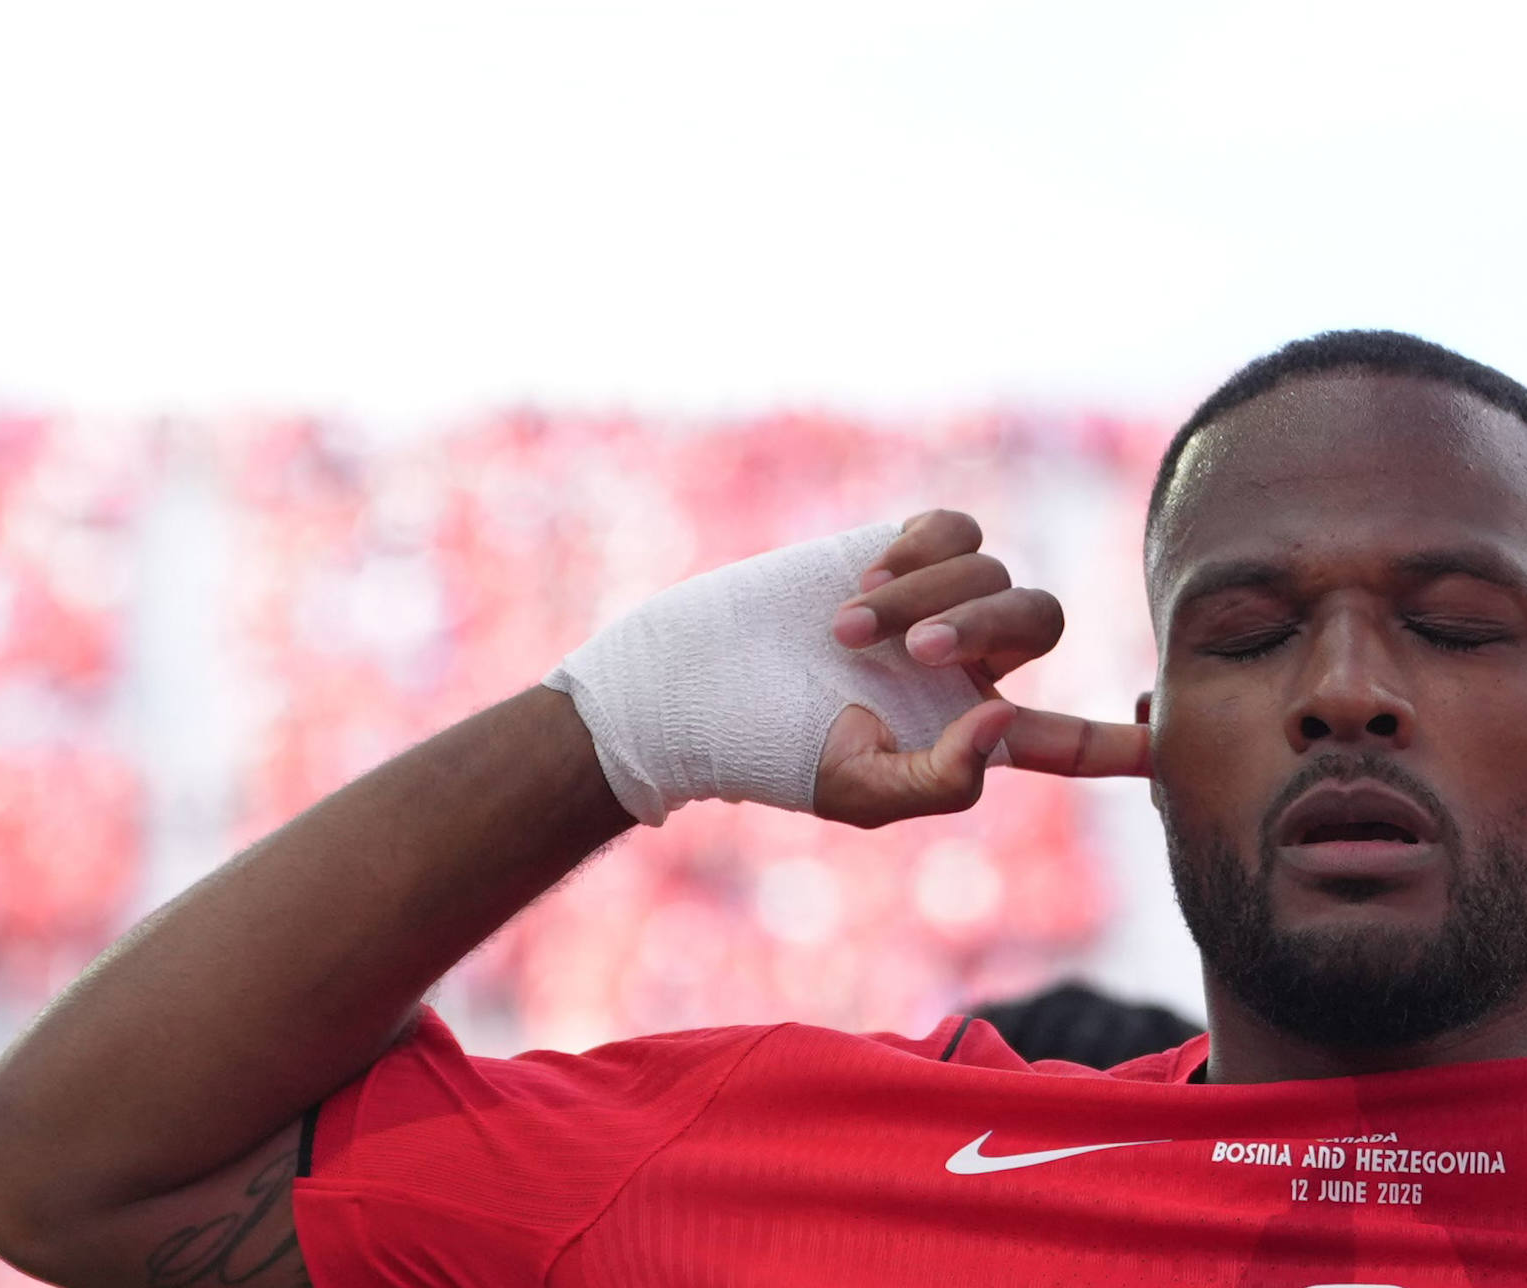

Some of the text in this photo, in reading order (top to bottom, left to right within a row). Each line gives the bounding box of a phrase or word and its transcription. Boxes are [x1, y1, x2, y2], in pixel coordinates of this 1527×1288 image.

[1212, 1141, 1506, 1175] BOSNIA AND HERZEGOVINA
[1291, 1179, 1423, 1205] 12 JUNE 2026
